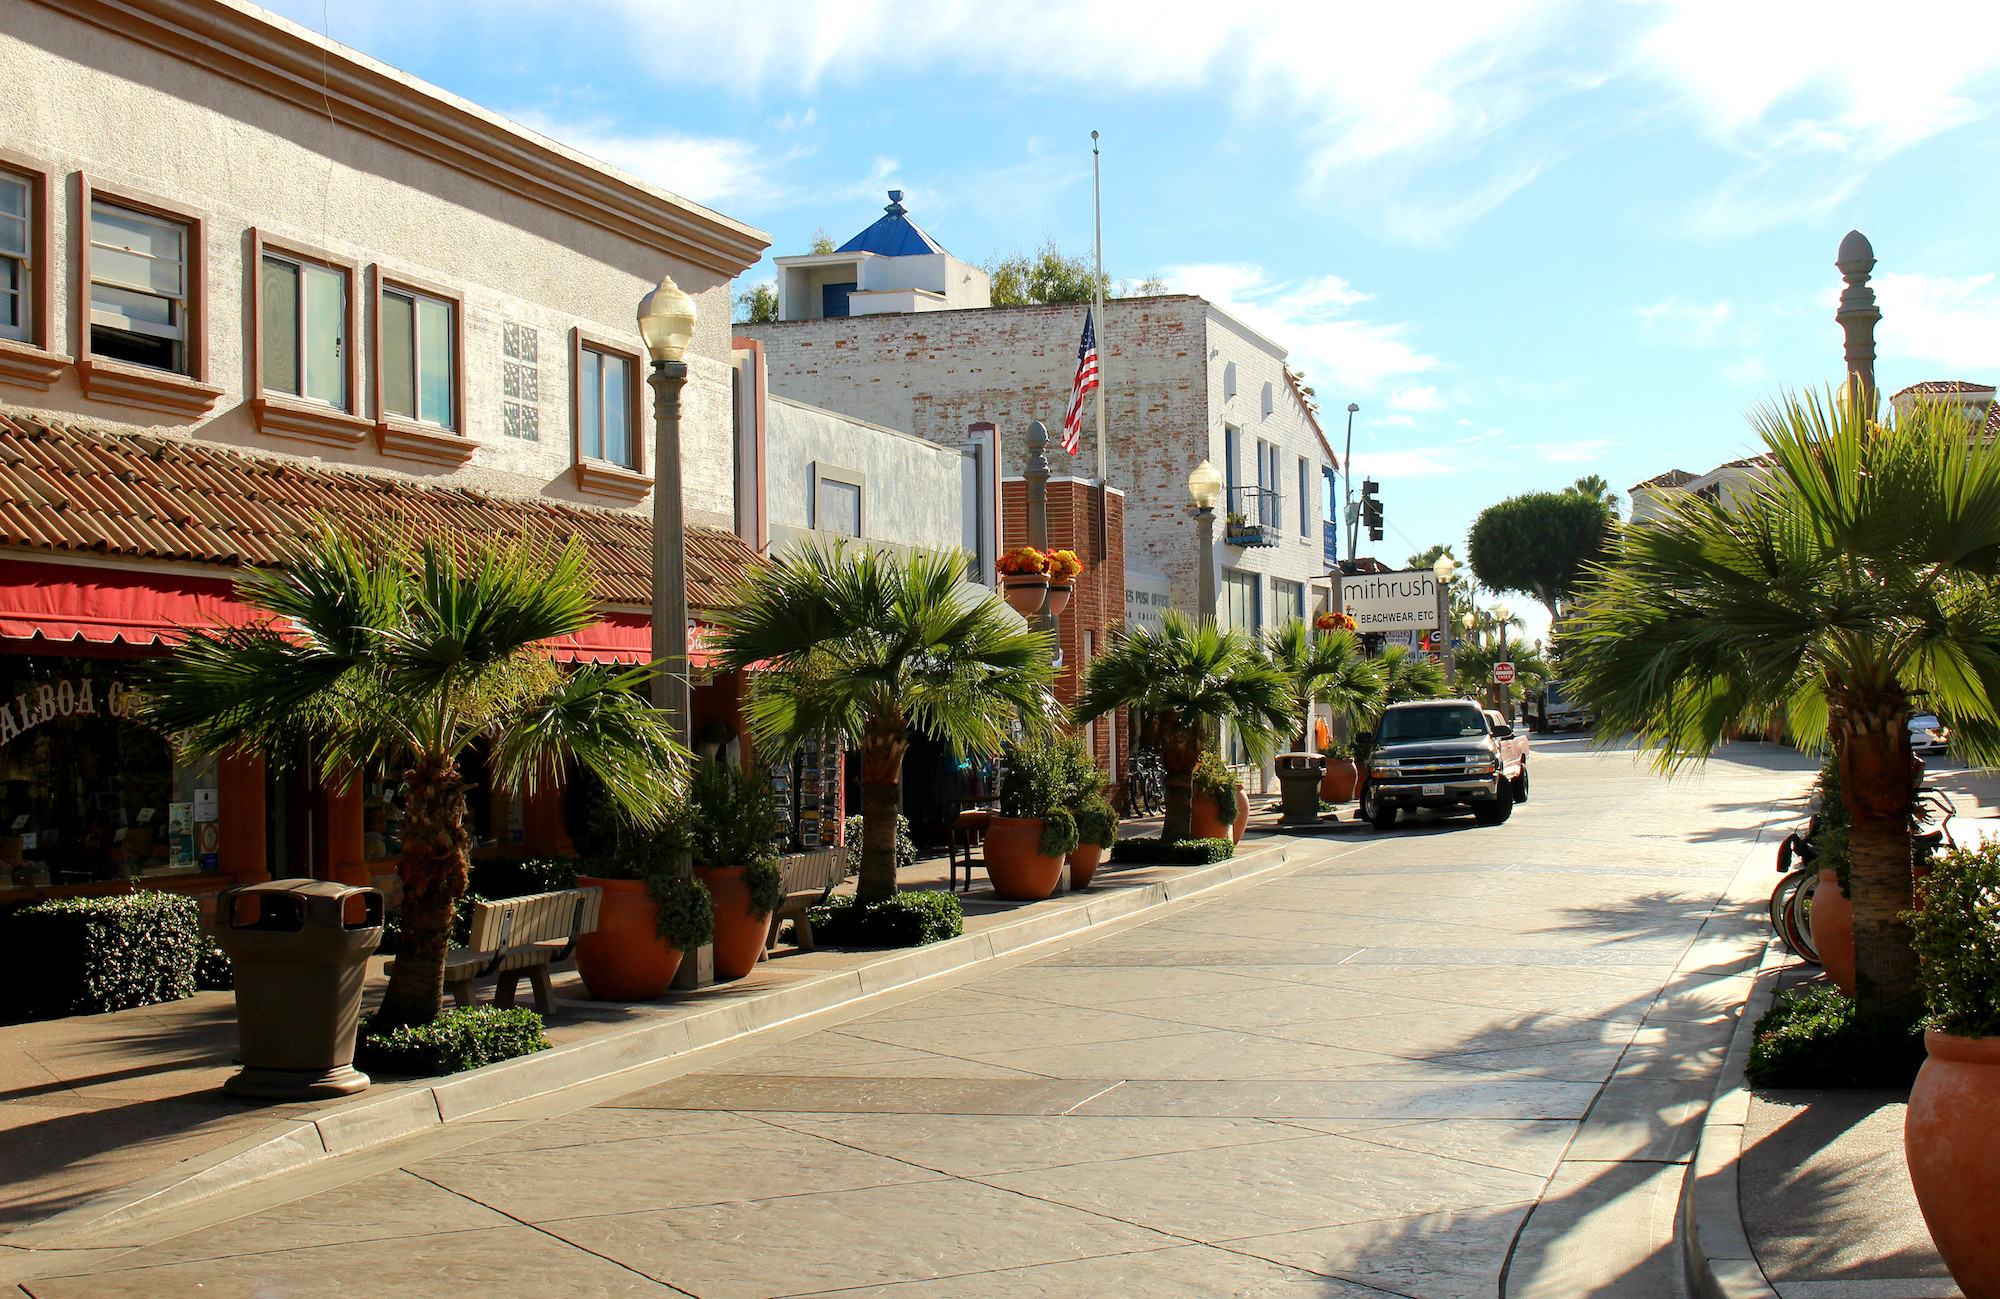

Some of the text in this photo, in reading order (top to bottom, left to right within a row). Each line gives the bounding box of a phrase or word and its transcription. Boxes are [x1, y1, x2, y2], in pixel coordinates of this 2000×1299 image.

[1344, 575, 1434, 600] mithrush
[1136, 591, 1149, 605] POST
[1417, 611, 1434, 620] ETC
